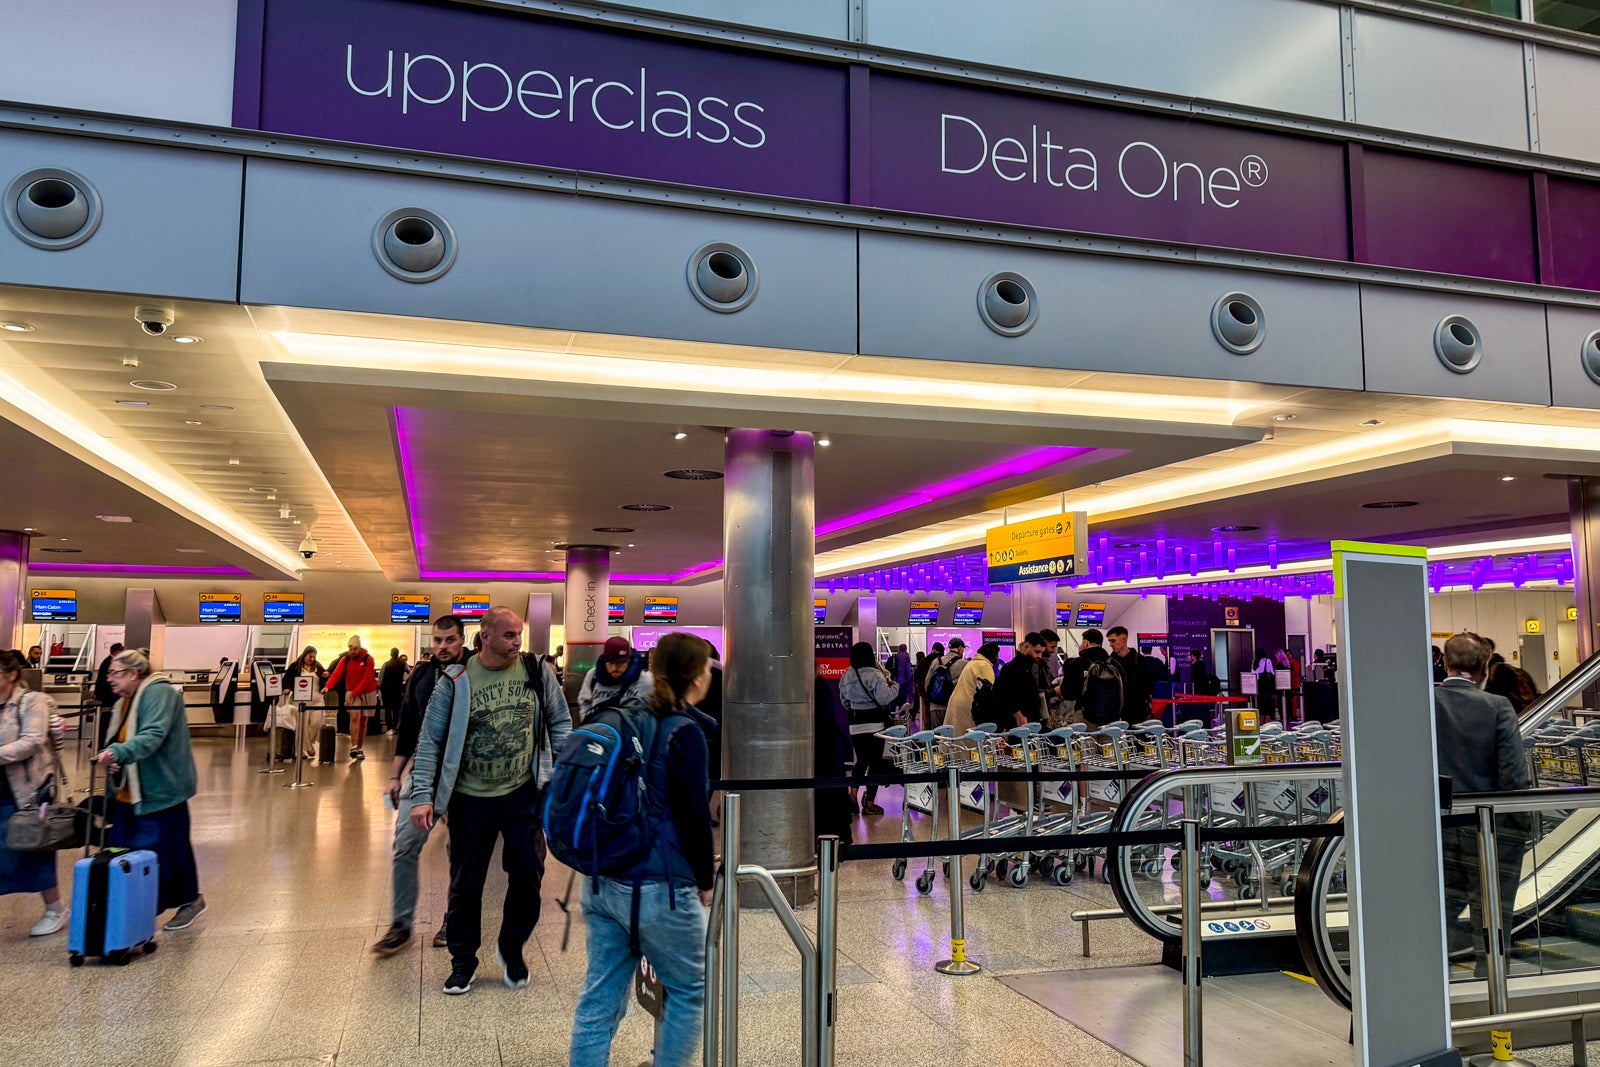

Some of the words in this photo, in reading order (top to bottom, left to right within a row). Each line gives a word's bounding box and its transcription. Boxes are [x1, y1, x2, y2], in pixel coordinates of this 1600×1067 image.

[345, 44, 766, 149] upperclass
[941, 113, 1098, 191] Delta
[1012, 530, 1038, 541] Departure
[1040, 525, 1055, 537] gates
[1015, 549, 1028, 557] Toilets
[1018, 563, 1049, 576] Assistance
[585, 581, 596, 591] in
[584, 595, 596, 632] Check
